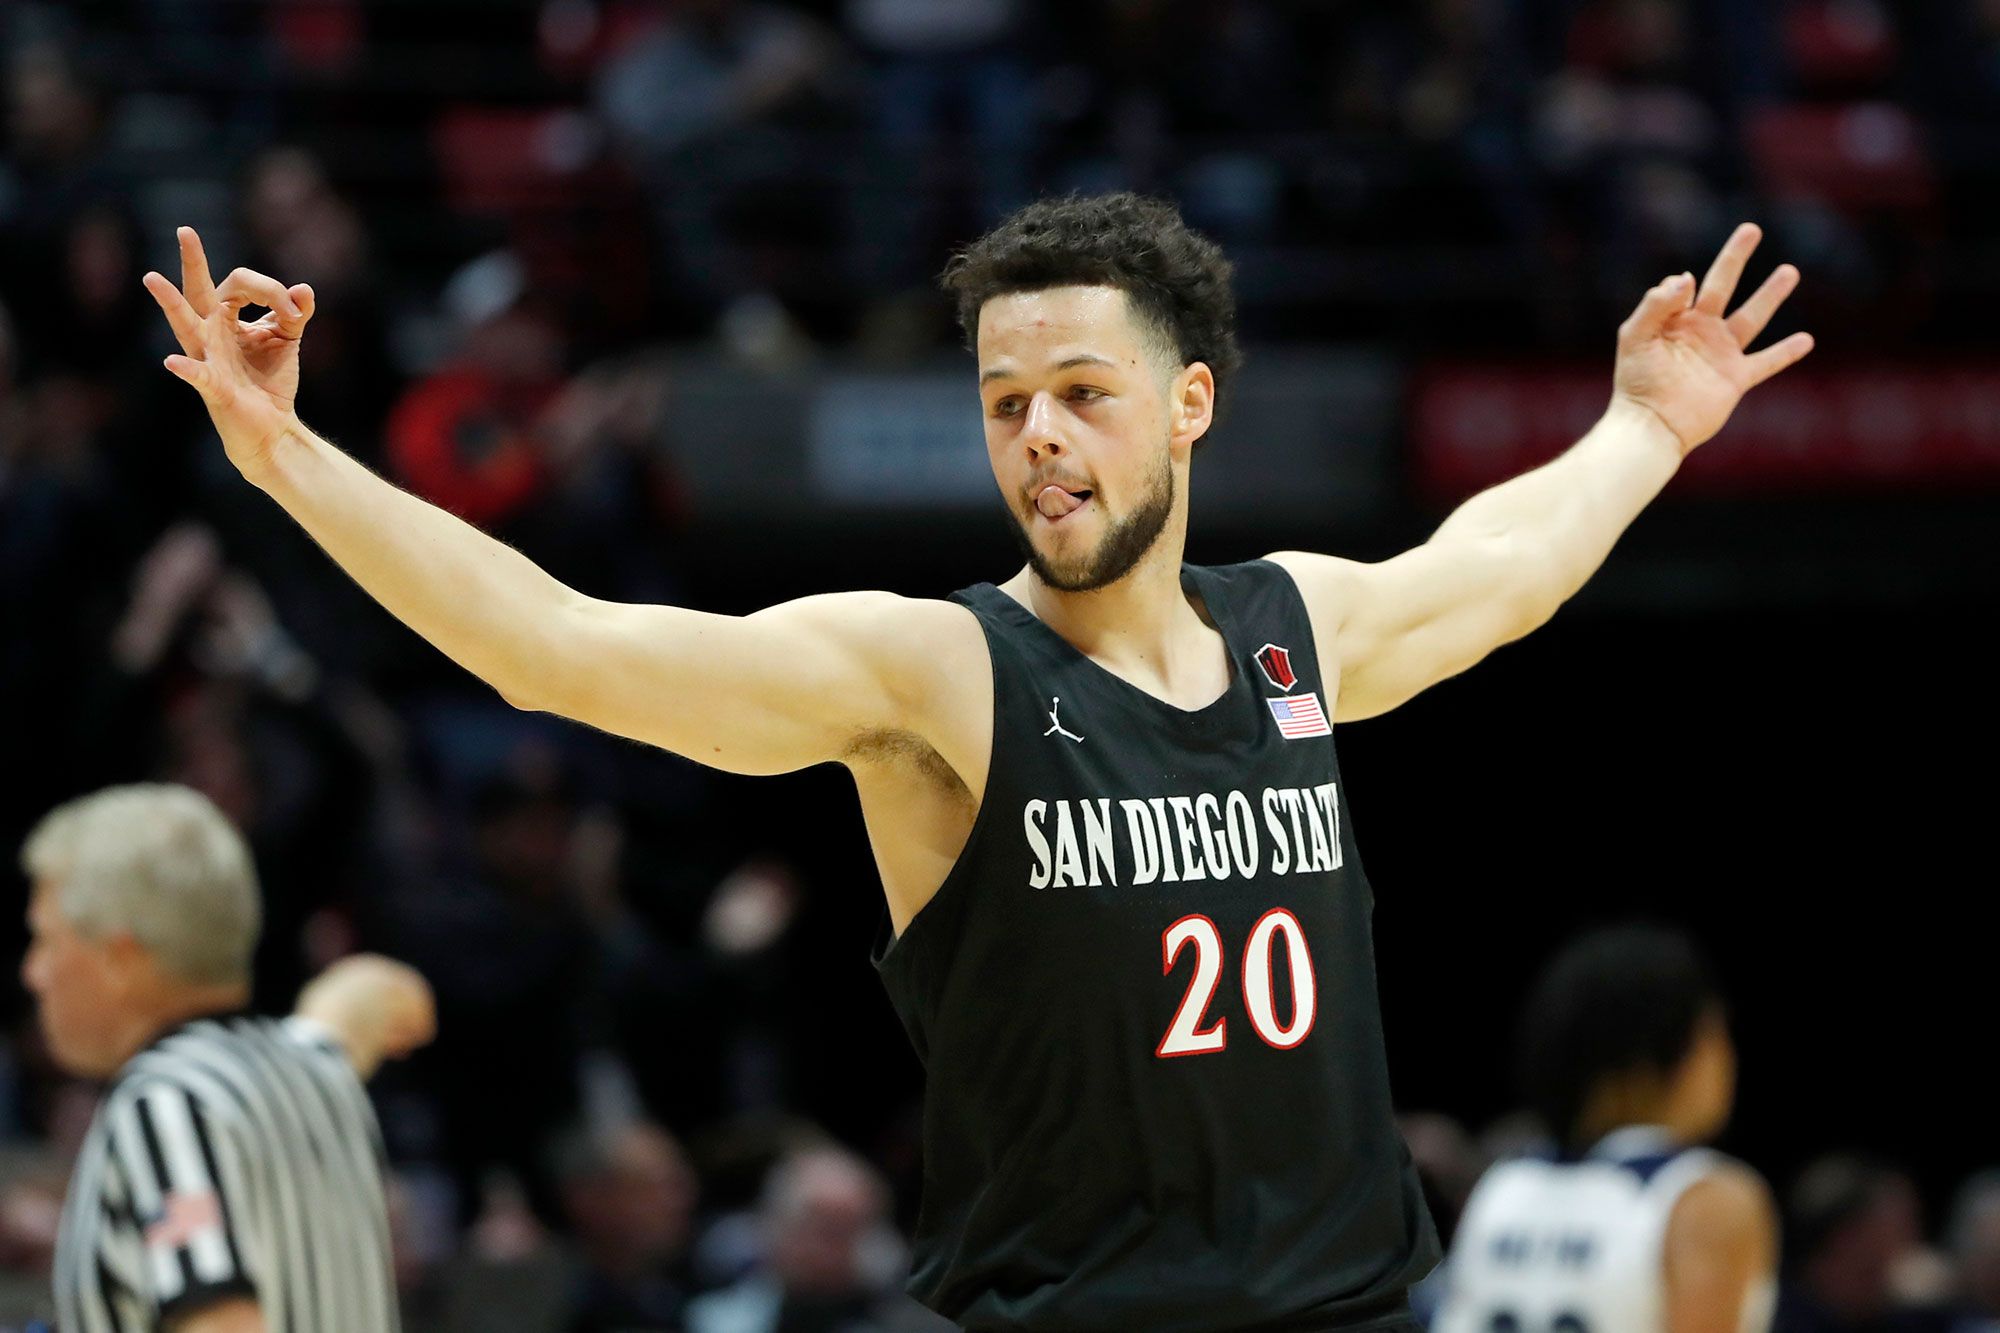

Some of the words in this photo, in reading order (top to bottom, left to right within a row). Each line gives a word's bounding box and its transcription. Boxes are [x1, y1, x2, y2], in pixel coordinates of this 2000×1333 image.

[1024, 798, 1118, 889] SAN
[1119, 790, 1259, 885] DIEGO
[1156, 907, 1317, 1057] 20
